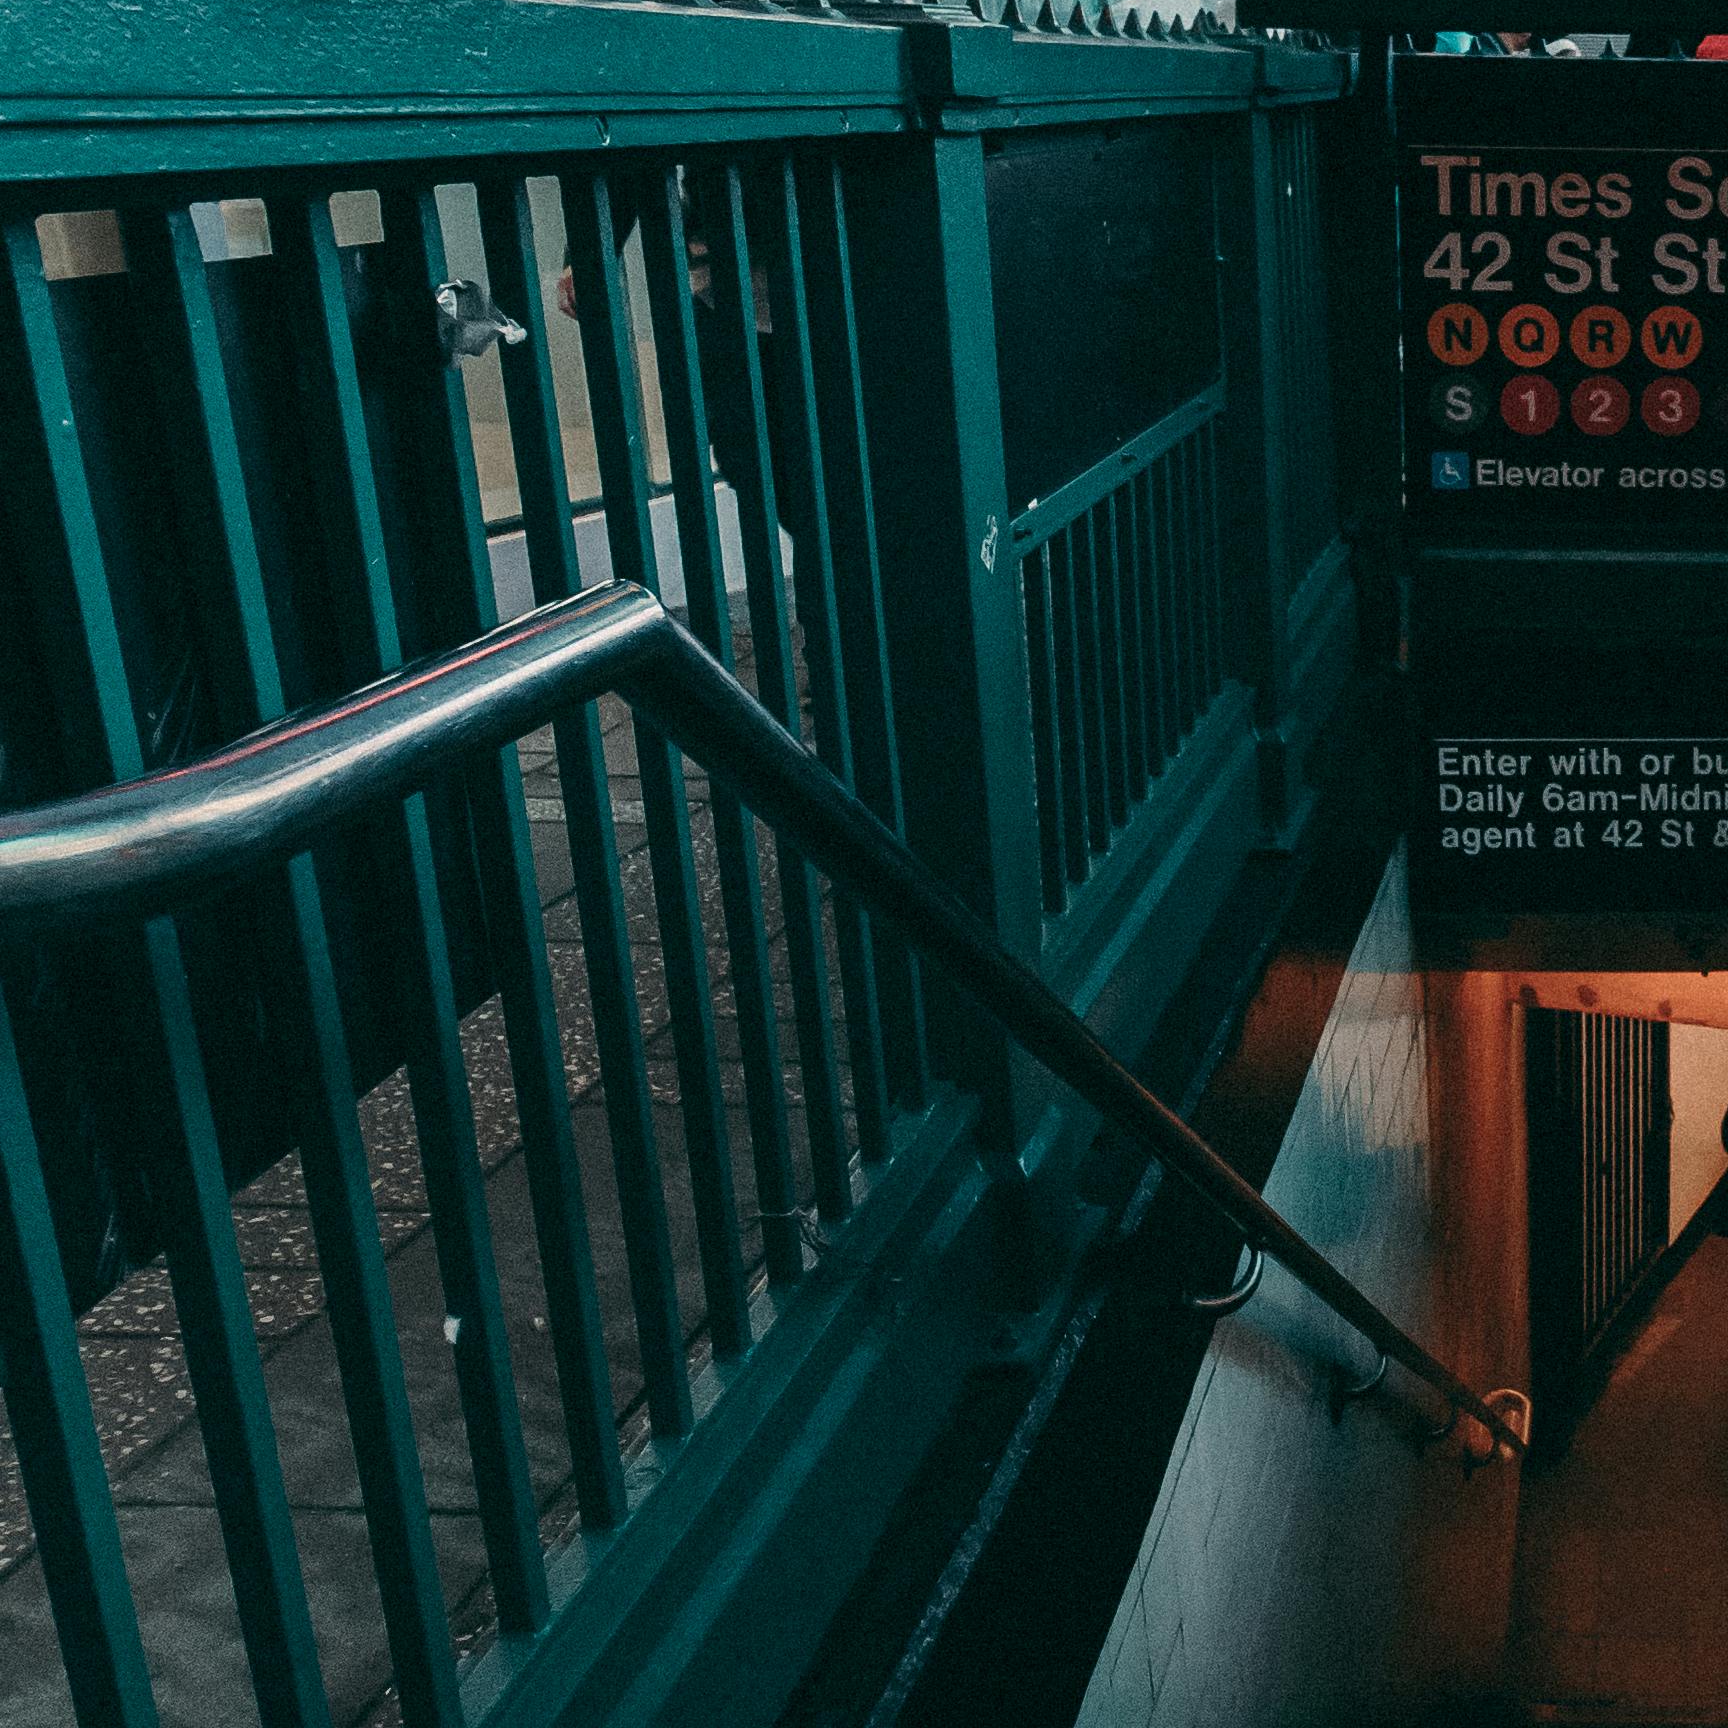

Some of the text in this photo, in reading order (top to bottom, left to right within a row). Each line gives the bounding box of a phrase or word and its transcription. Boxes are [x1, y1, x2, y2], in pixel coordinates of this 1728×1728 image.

[1420, 155, 1633, 218] Times
[1423, 230, 1514, 291] 42
[1544, 231, 1620, 294] St
[1443, 316, 1692, 356] N Q R W
[1446, 385, 1473, 422] S
[1520, 389, 1537, 422] 1
[1588, 389, 1612, 423] 2
[1659, 389, 1683, 423] 3
[1475, 458, 1605, 488] Elevator
[1617, 465, 1727, 489] across
[1437, 746, 1532, 776] Enter
[1548, 746, 1623, 776] with
[1639, 752, 1676, 776] or
[1439, 784, 1525, 818] Daily
[1441, 821, 1537, 856] agent
[1553, 821, 1585, 848] at
[1600, 819, 1644, 848] 42
[1660, 818, 1696, 848] St
